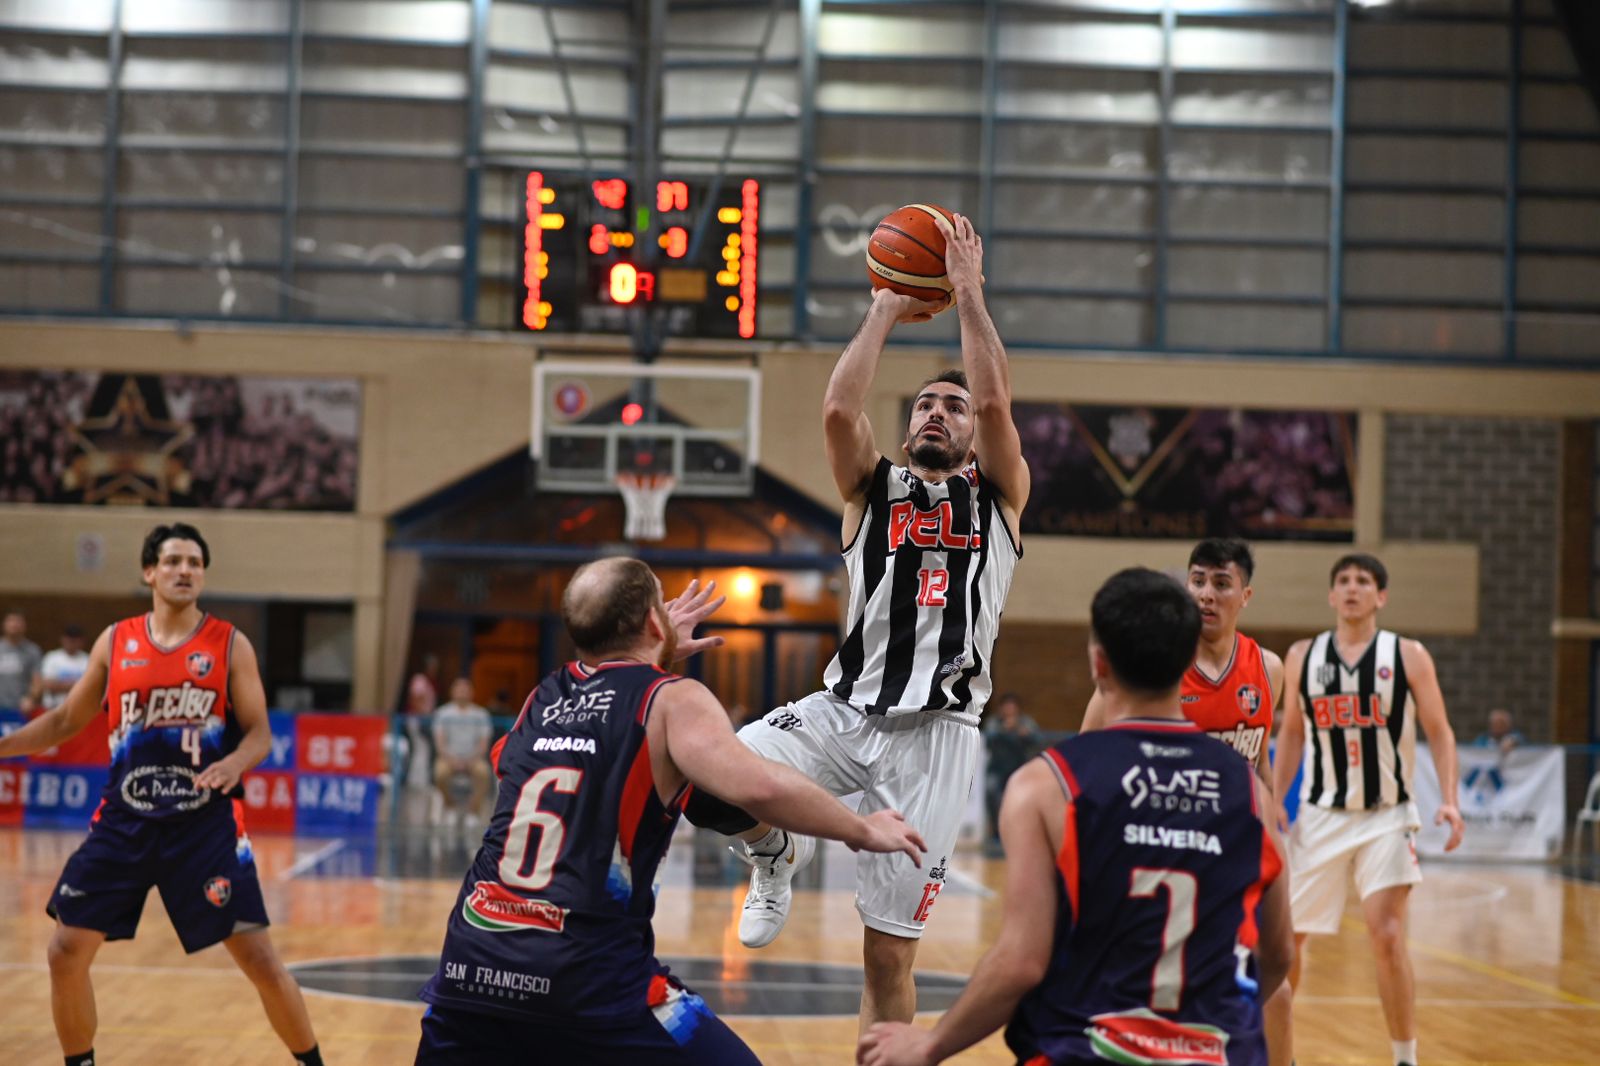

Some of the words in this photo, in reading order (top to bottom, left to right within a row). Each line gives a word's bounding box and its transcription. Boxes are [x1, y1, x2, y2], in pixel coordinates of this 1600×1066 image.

[888, 500, 981, 553] BEL
[917, 568, 948, 607] 12
[1312, 692, 1387, 729] BELL
[181, 727, 201, 766] 4
[533, 736, 596, 755] RIGADA
[499, 766, 584, 890] 6
[1124, 823, 1222, 855] SILVEIRA
[913, 882, 941, 921] 12
[1128, 866, 1197, 1011] 7
[445, 961, 467, 980] SAN
[475, 966, 551, 995] FRANCISCO
